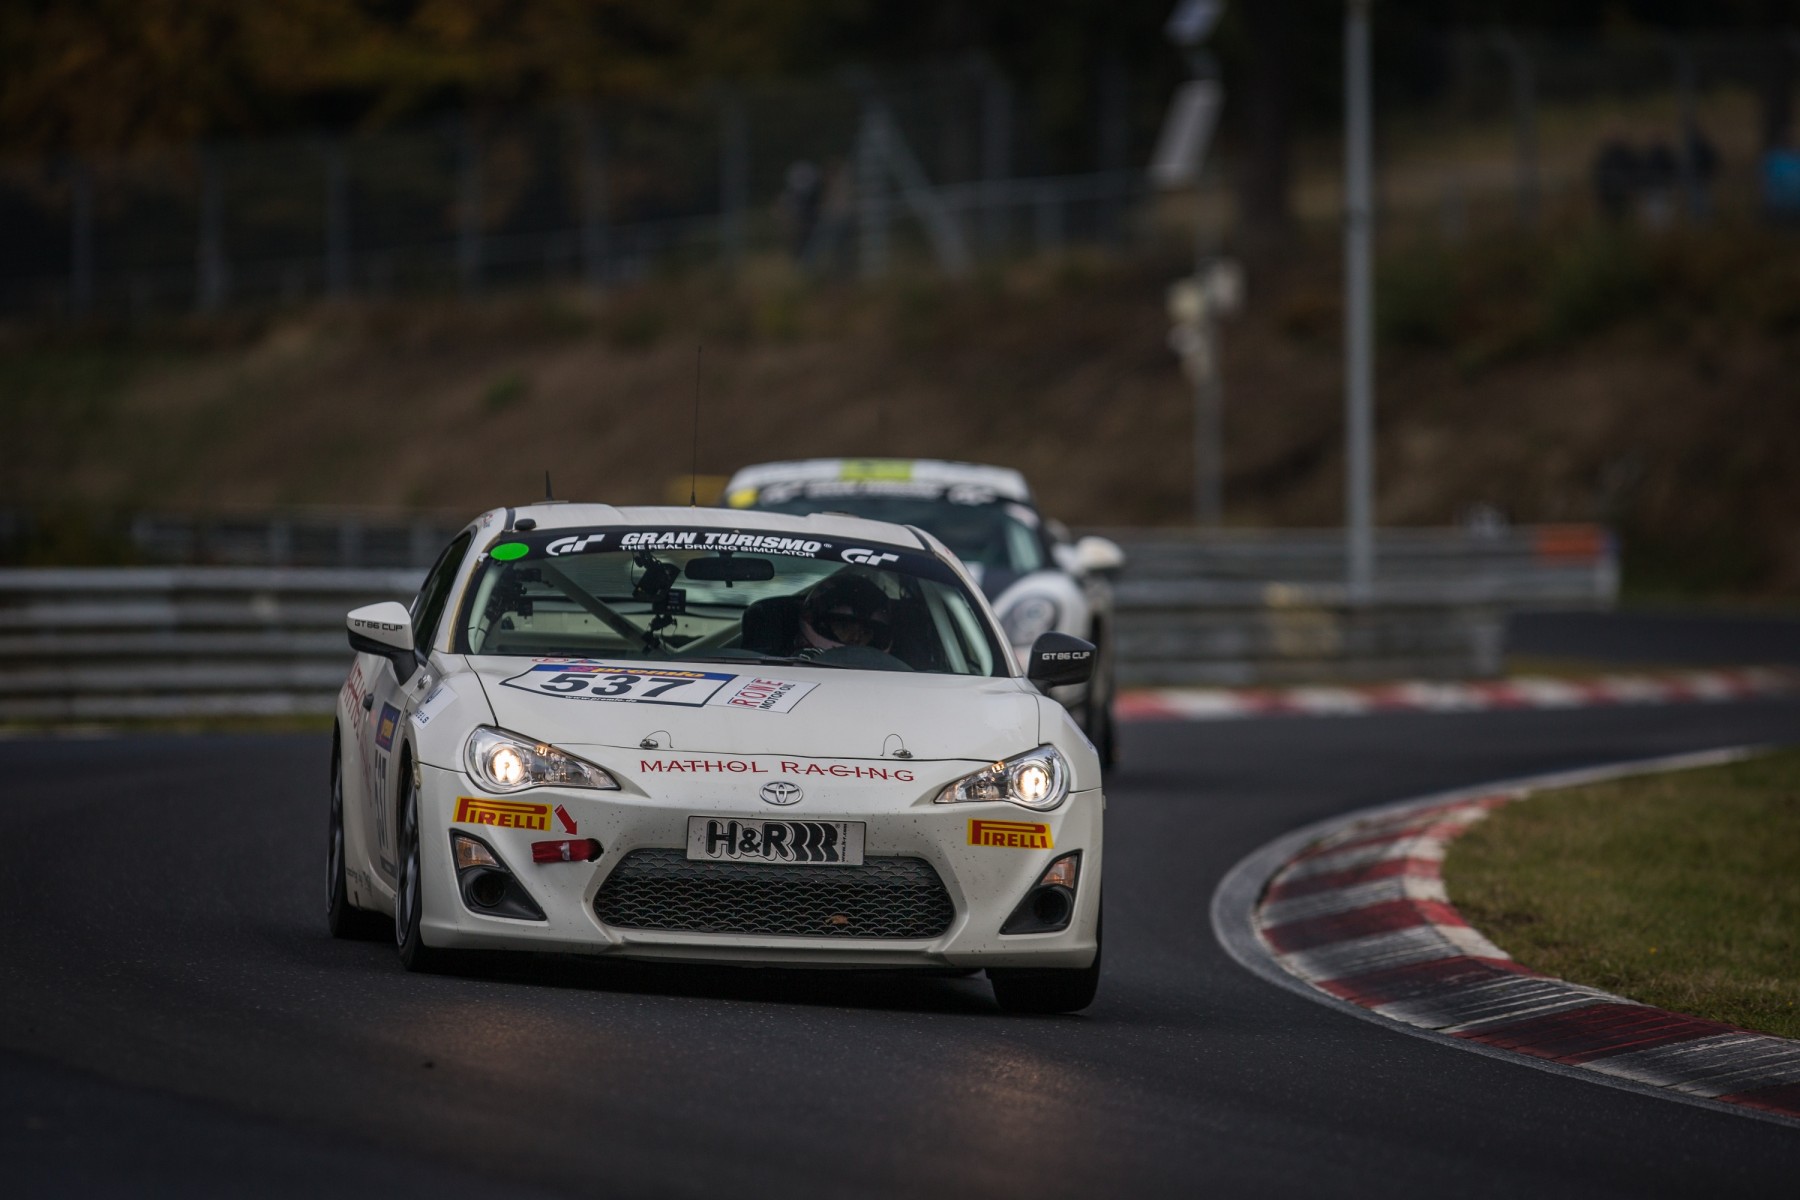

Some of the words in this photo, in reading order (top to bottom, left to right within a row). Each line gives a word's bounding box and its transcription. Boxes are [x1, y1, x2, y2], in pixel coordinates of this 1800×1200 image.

[621, 532, 697, 545] GRAN
[684, 544, 738, 552] DRIVING
[740, 545, 816, 558] SIMULATOR
[382, 623, 403, 632] CUP
[1072, 651, 1090, 660] CUP
[540, 673, 697, 698] 537
[731, 677, 784, 707] ROWE
[759, 690, 787, 709] MOTOR
[640, 759, 768, 773] MATHOL
[781, 760, 915, 782] RACING
[456, 797, 548, 830] PIRELLI
[971, 819, 1048, 848] PIRELLI
